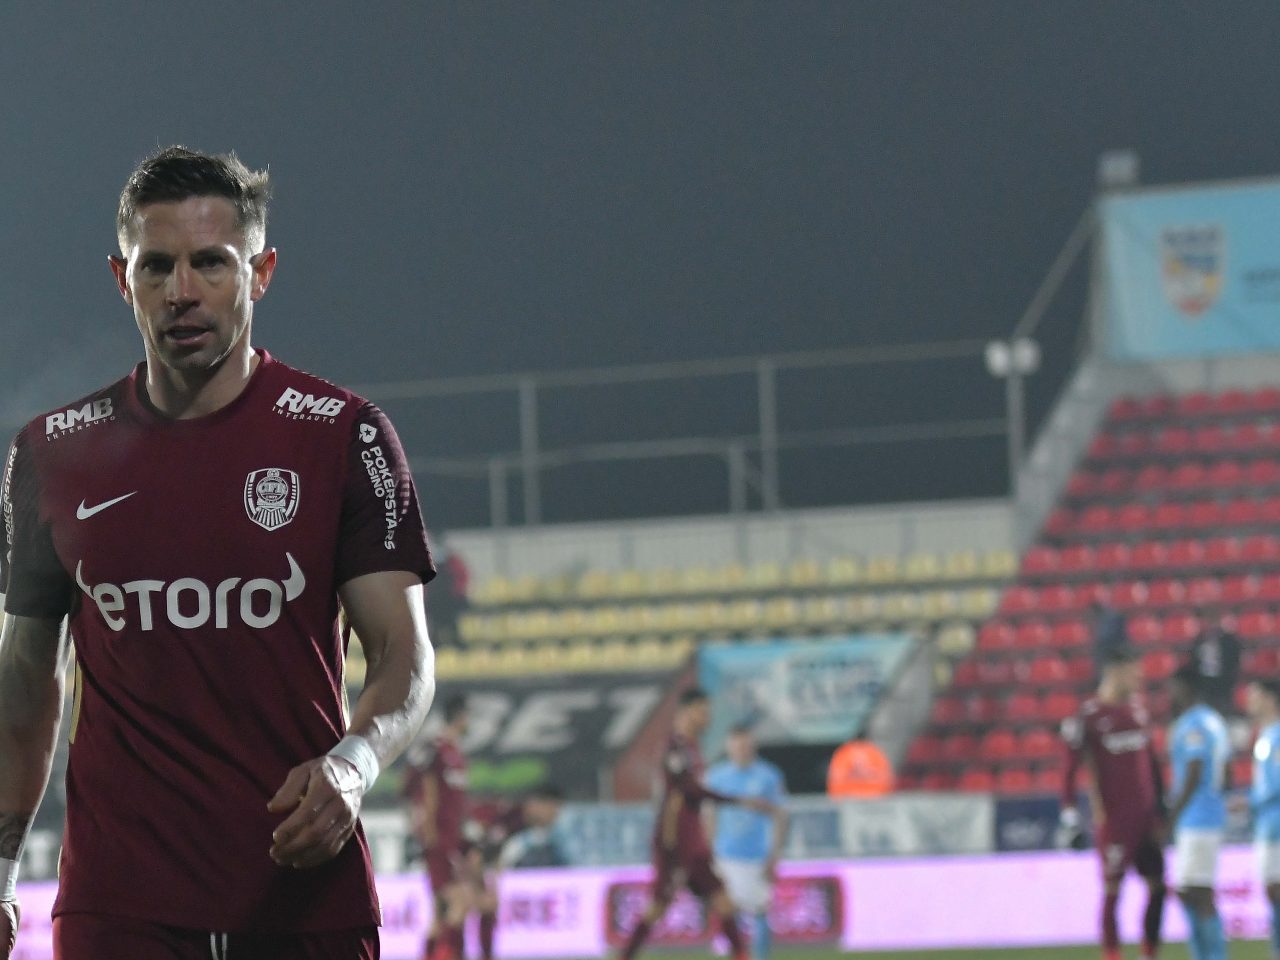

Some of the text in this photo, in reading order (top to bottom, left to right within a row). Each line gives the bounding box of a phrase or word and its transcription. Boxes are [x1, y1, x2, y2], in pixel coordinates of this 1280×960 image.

[45, 397, 114, 435] RMB
[271, 404, 336, 425] INTERAUTO
[275, 386, 346, 417] RMB
[46, 415, 116, 442] INTERAUTO
[360, 449, 386, 499] CASINO
[369, 445, 398, 551] POKERSTARS
